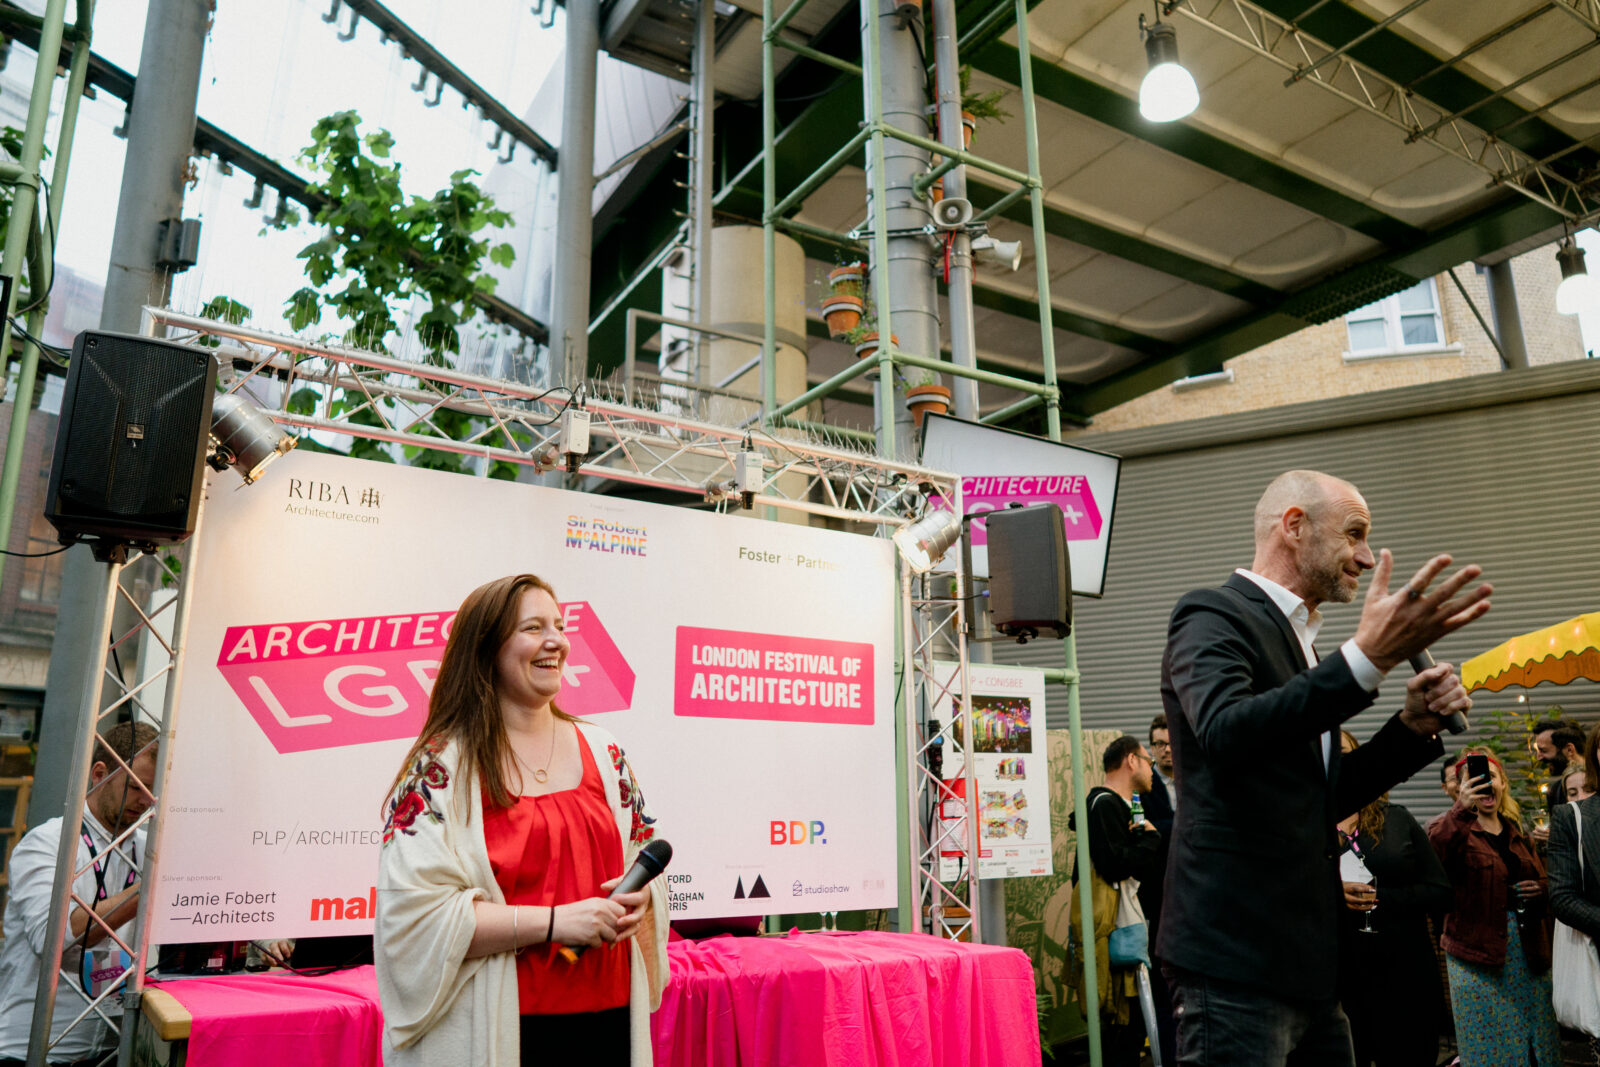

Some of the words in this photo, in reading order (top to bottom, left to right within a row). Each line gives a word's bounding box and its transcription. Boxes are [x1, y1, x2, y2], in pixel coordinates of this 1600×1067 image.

[288, 478, 350, 505] RIBA
[961, 476, 1084, 495] CHITECTURE
[284, 503, 380, 525] Architecture.com
[567, 515, 590, 529] Sir
[592, 518, 648, 537] Robert
[738, 546, 782, 565] Foster
[227, 604, 584, 662] ARCHITEE
[691, 644, 760, 670] LONDON
[764, 651, 839, 676] FESTIVAL
[841, 657, 862, 678] OF
[690, 672, 862, 709] ARCHITECTURE
[168, 806, 188, 814] Gold
[667, 874, 693, 884] FORD
[171, 892, 220, 908] Jamie
[225, 890, 277, 906] Fobert
[668, 892, 705, 902] NAGHAN
[804, 884, 850, 895] studioshaw
